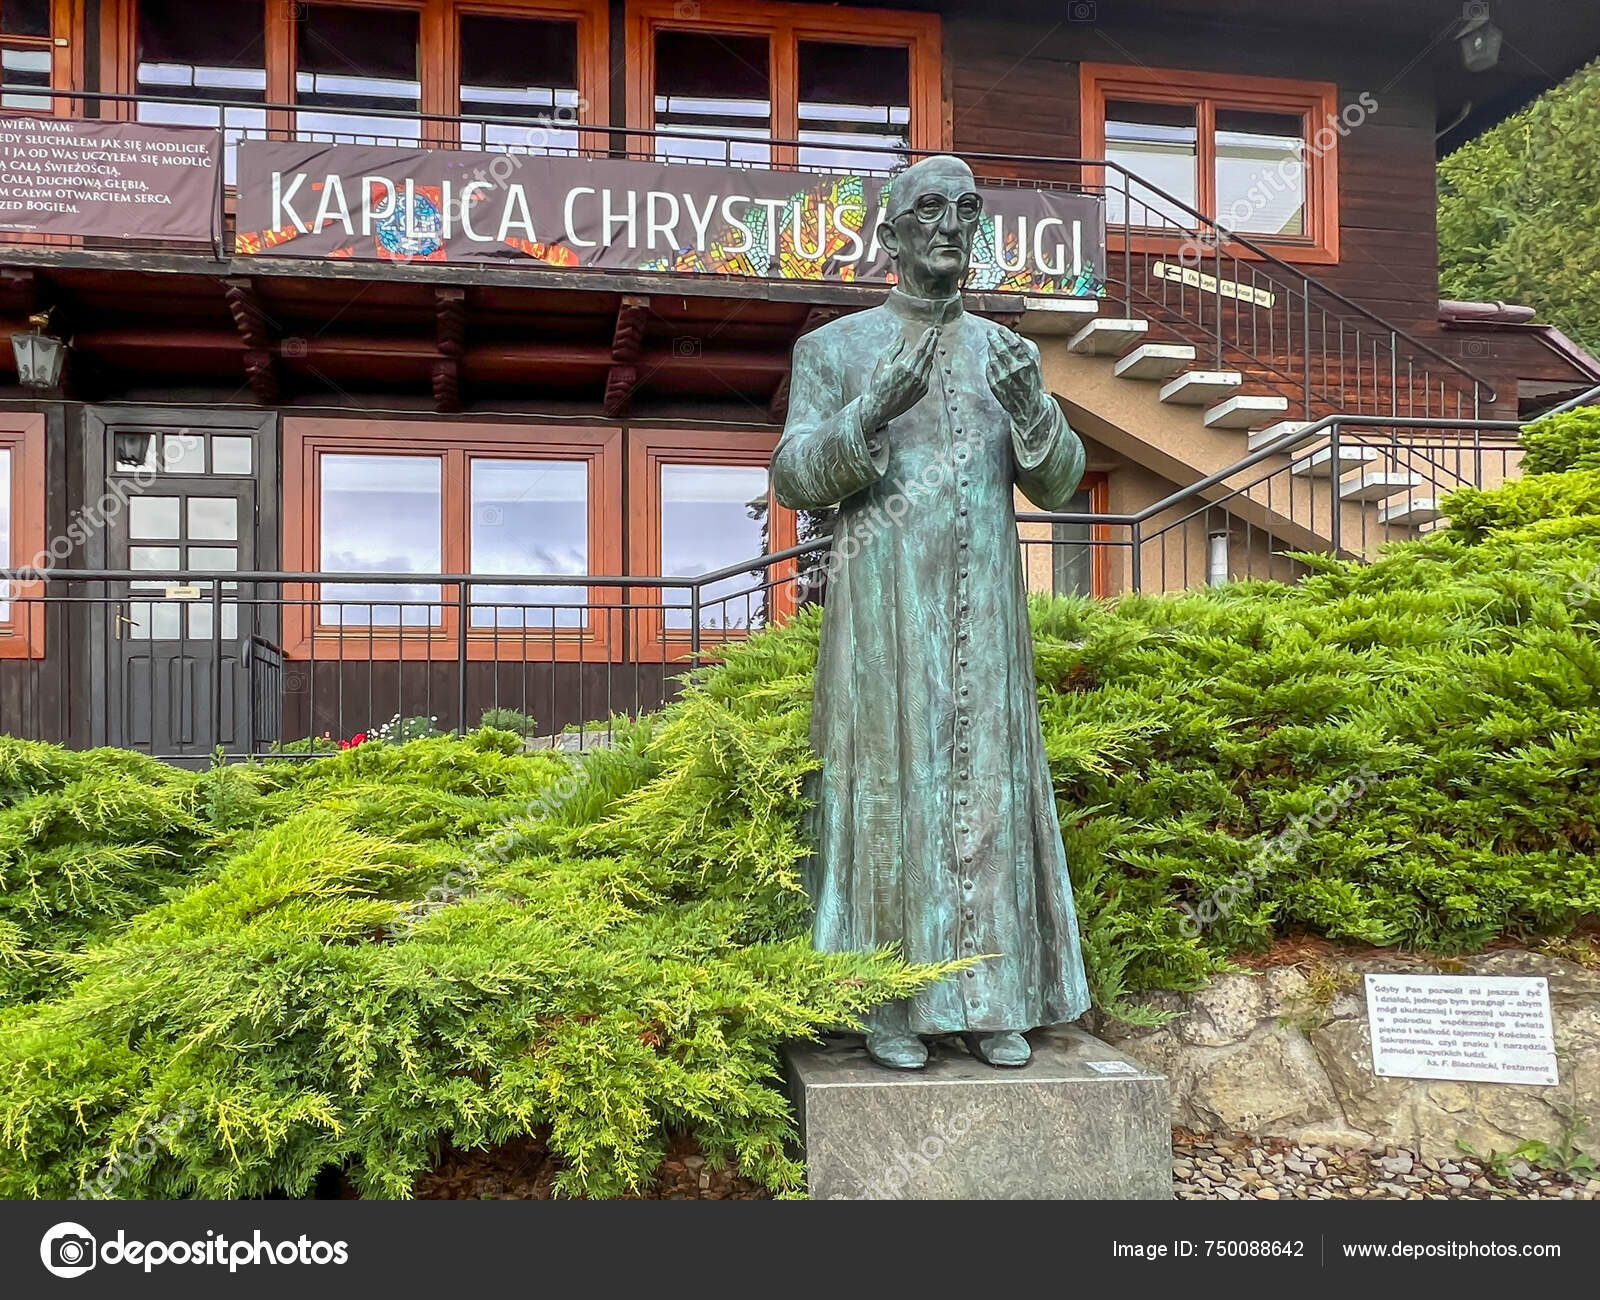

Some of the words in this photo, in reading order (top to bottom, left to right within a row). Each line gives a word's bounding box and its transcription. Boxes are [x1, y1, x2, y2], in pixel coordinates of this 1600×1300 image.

[40, 121, 74, 132] WAM:
[25, 135, 97, 148] SŁUCHAŁEM
[101, 138, 120, 149] JAK
[124, 140, 141, 152] SIĘ
[13, 147, 26, 158] JA
[29, 148, 49, 158] OD
[52, 148, 79, 160] WAS
[82, 151, 137, 163] UCZYŁEM
[141, 154, 158, 167] SIĘ
[162, 155, 212, 168] MODLIĆ
[10, 161, 41, 174] CAŁĄ
[2, 173, 33, 186] CAŁĄ
[37, 176, 102, 190] DUCHOWĄ
[13, 188, 52, 198] CAŁYM
[56, 189, 132, 203] OTWARCIEM
[135, 193, 172, 205] SERCA
[271, 171, 538, 244] KAPLICA
